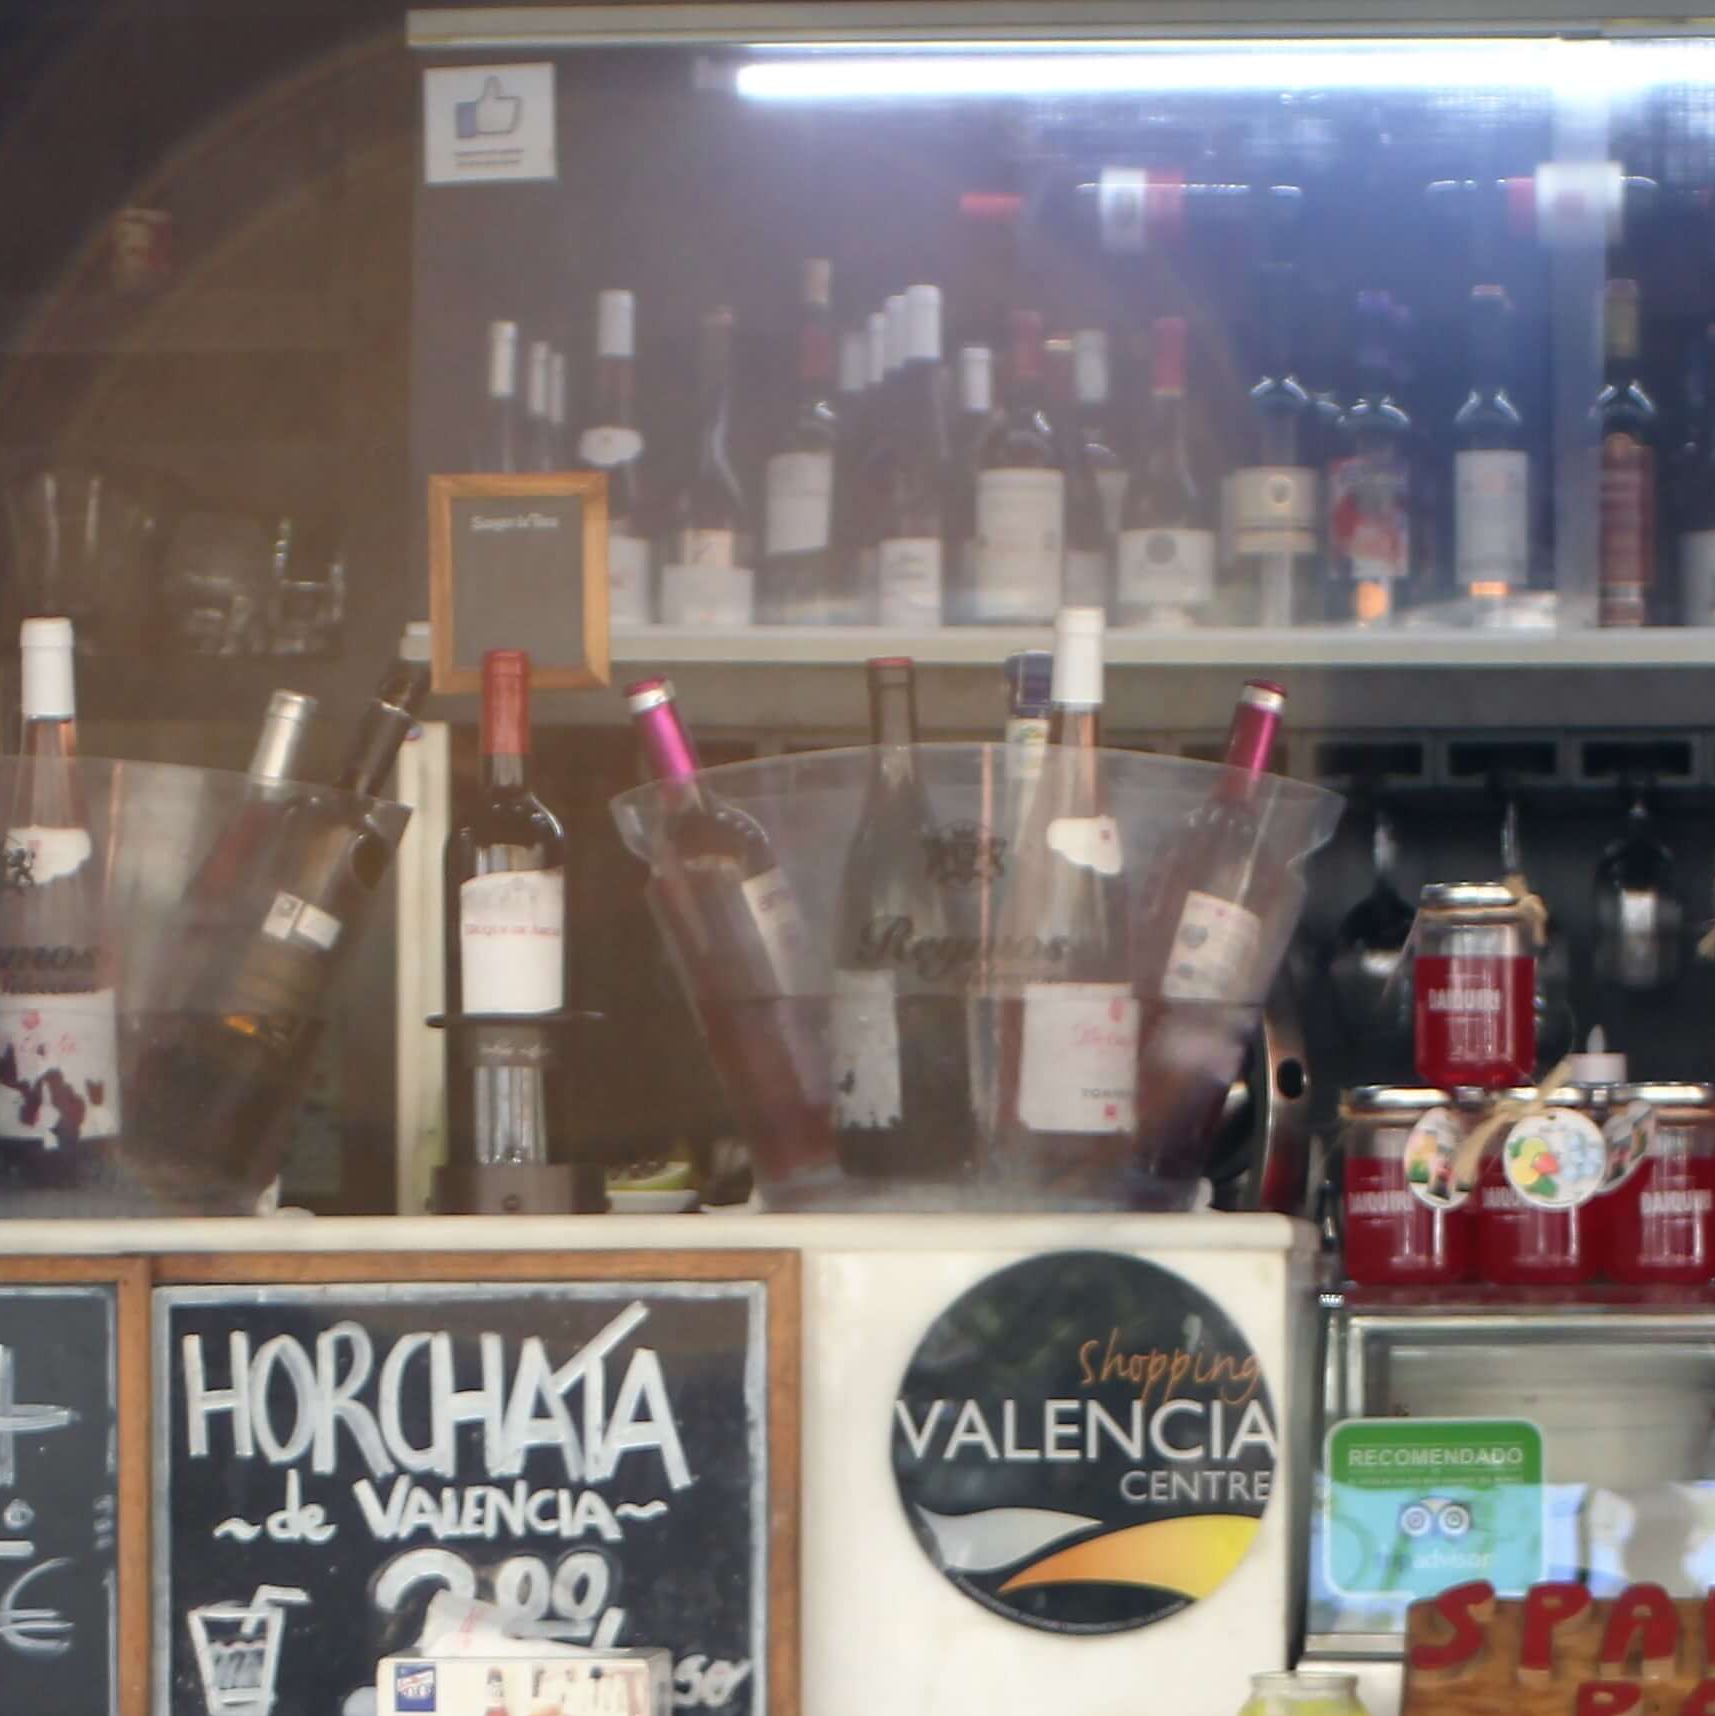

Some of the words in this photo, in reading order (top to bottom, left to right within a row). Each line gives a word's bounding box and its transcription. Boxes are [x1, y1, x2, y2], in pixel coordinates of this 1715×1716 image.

[183, 1300, 694, 1491] HORCHATA
[893, 1399, 1279, 1461] VALENCIA
[1348, 1447, 1524, 1467] RECOMENDADO
[352, 1474, 624, 1542] VALENCIA
[1120, 1470, 1273, 1502] CENTRE
